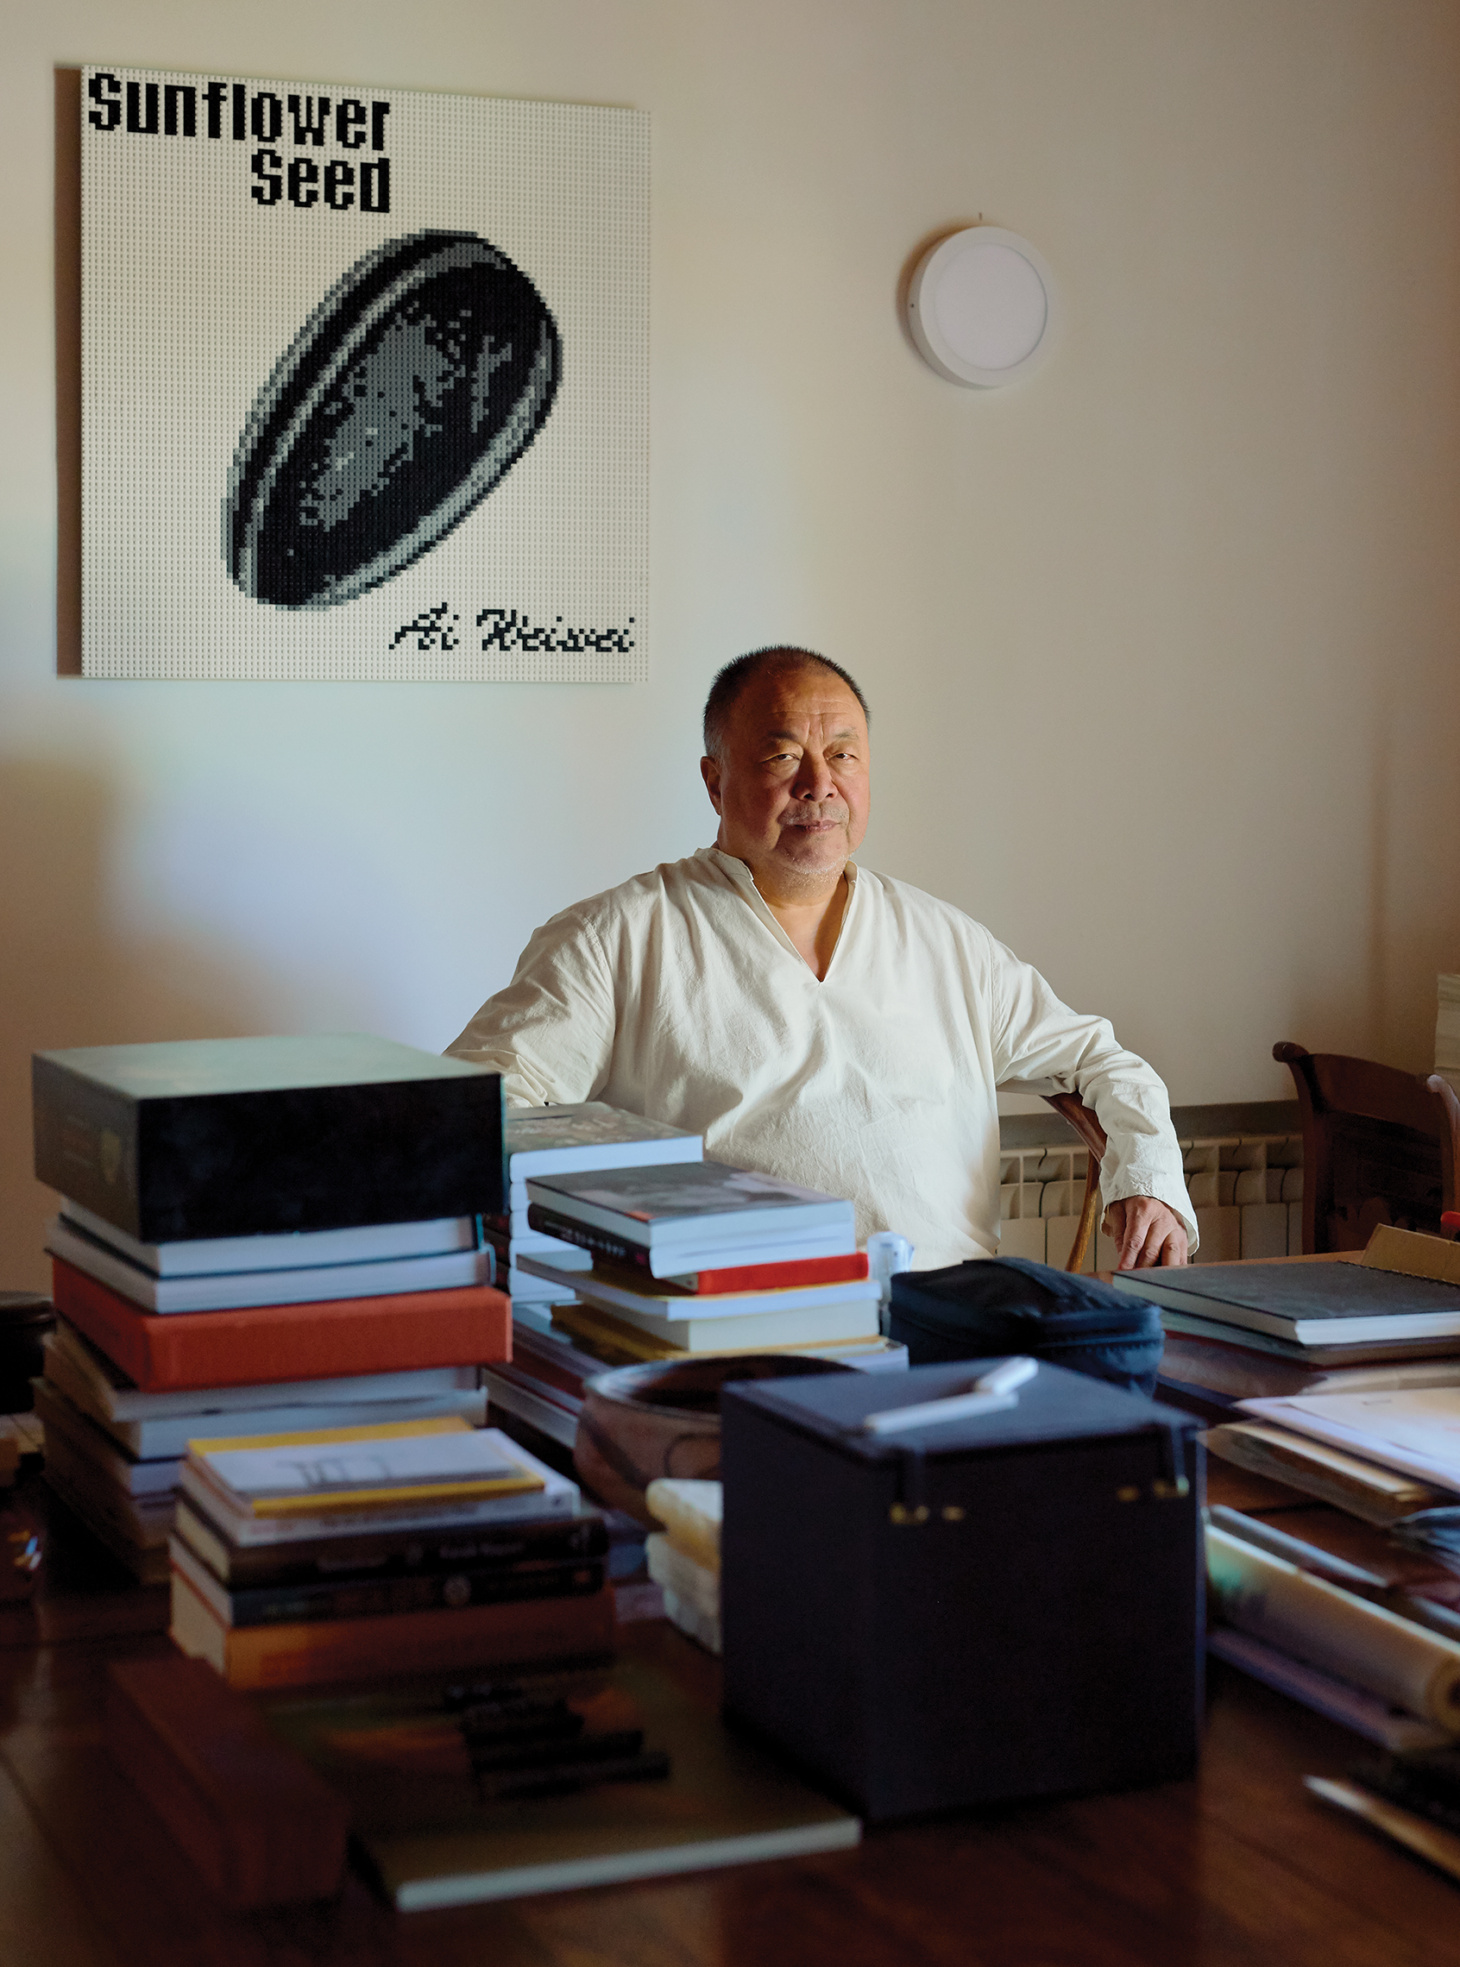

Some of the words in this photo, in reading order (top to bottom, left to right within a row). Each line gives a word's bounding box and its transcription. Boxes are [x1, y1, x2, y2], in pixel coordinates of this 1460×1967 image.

[89, 73, 391, 152] Sunflower
[251, 148, 391, 214] Seed
[388, 602, 460, 651] Ai
[476, 608, 635, 653] Weiwei
